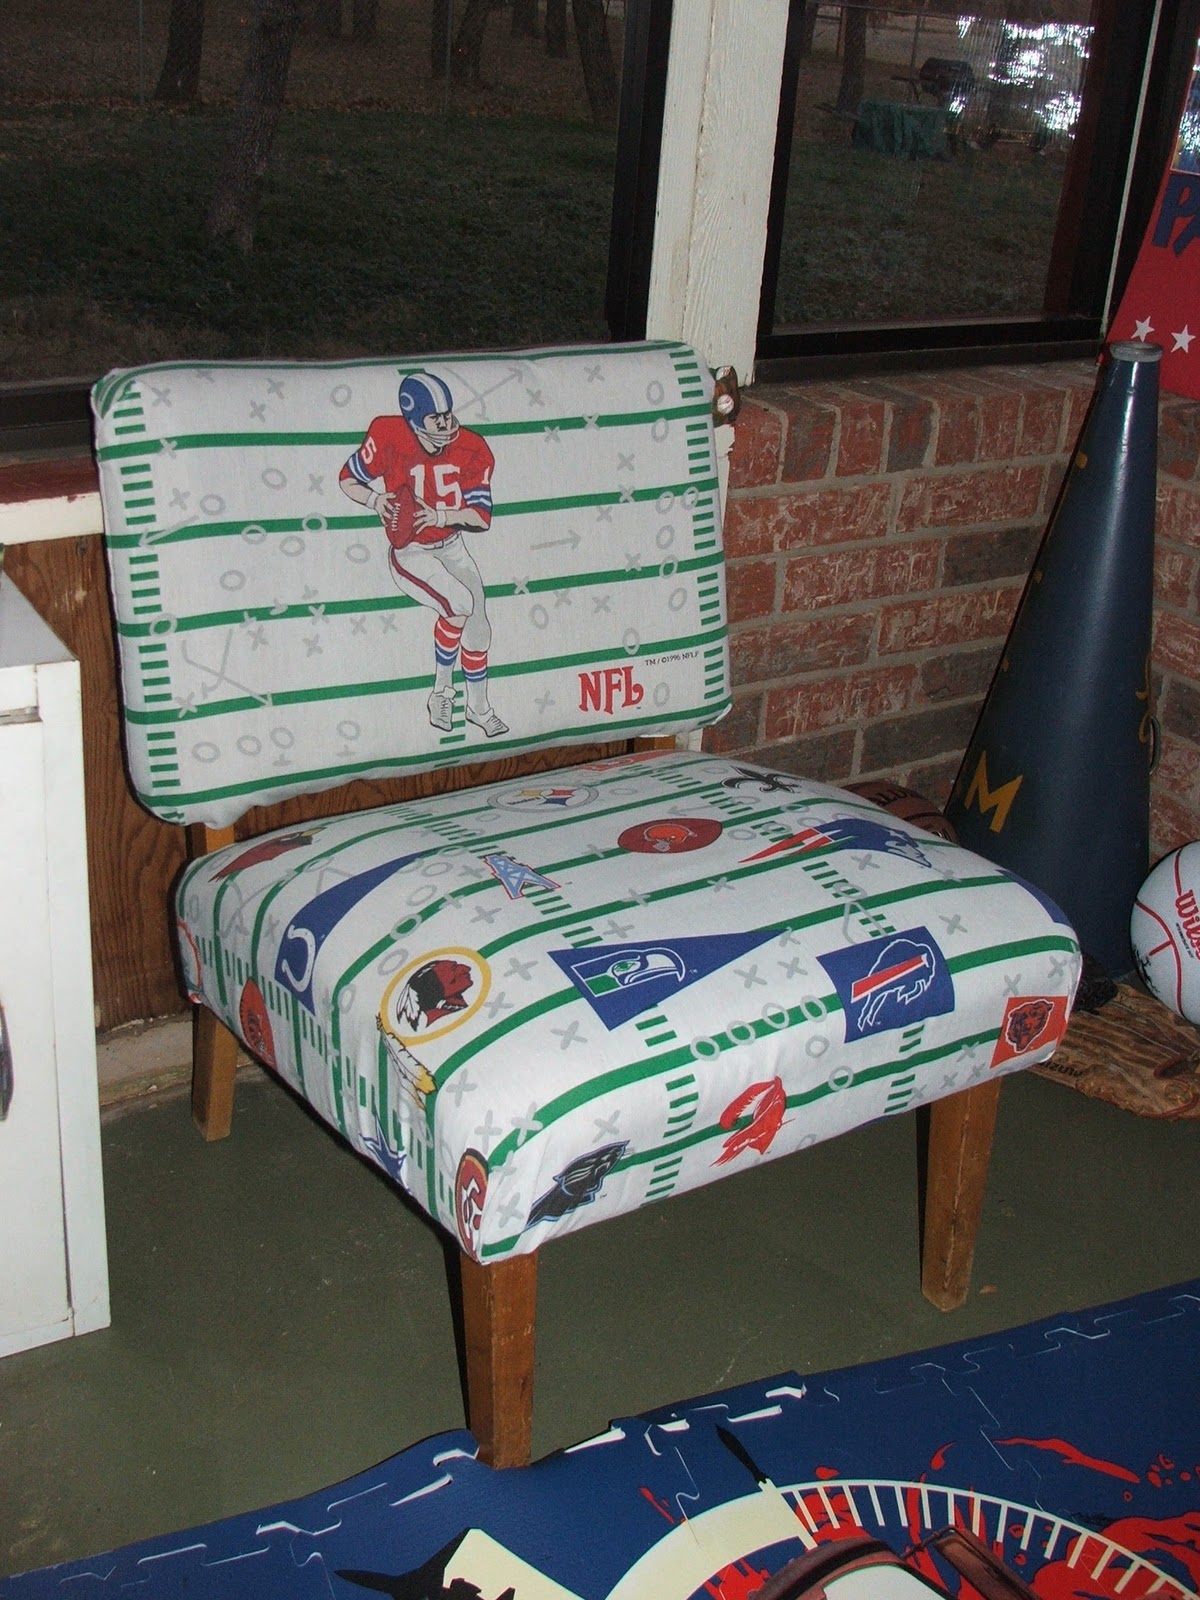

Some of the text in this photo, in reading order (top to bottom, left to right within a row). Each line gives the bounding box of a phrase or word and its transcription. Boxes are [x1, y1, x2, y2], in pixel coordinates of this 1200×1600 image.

[361, 437, 377, 464] 5
[410, 463, 463, 511] 15
[578, 666, 645, 715] NFL
[963, 750, 1024, 833] M
